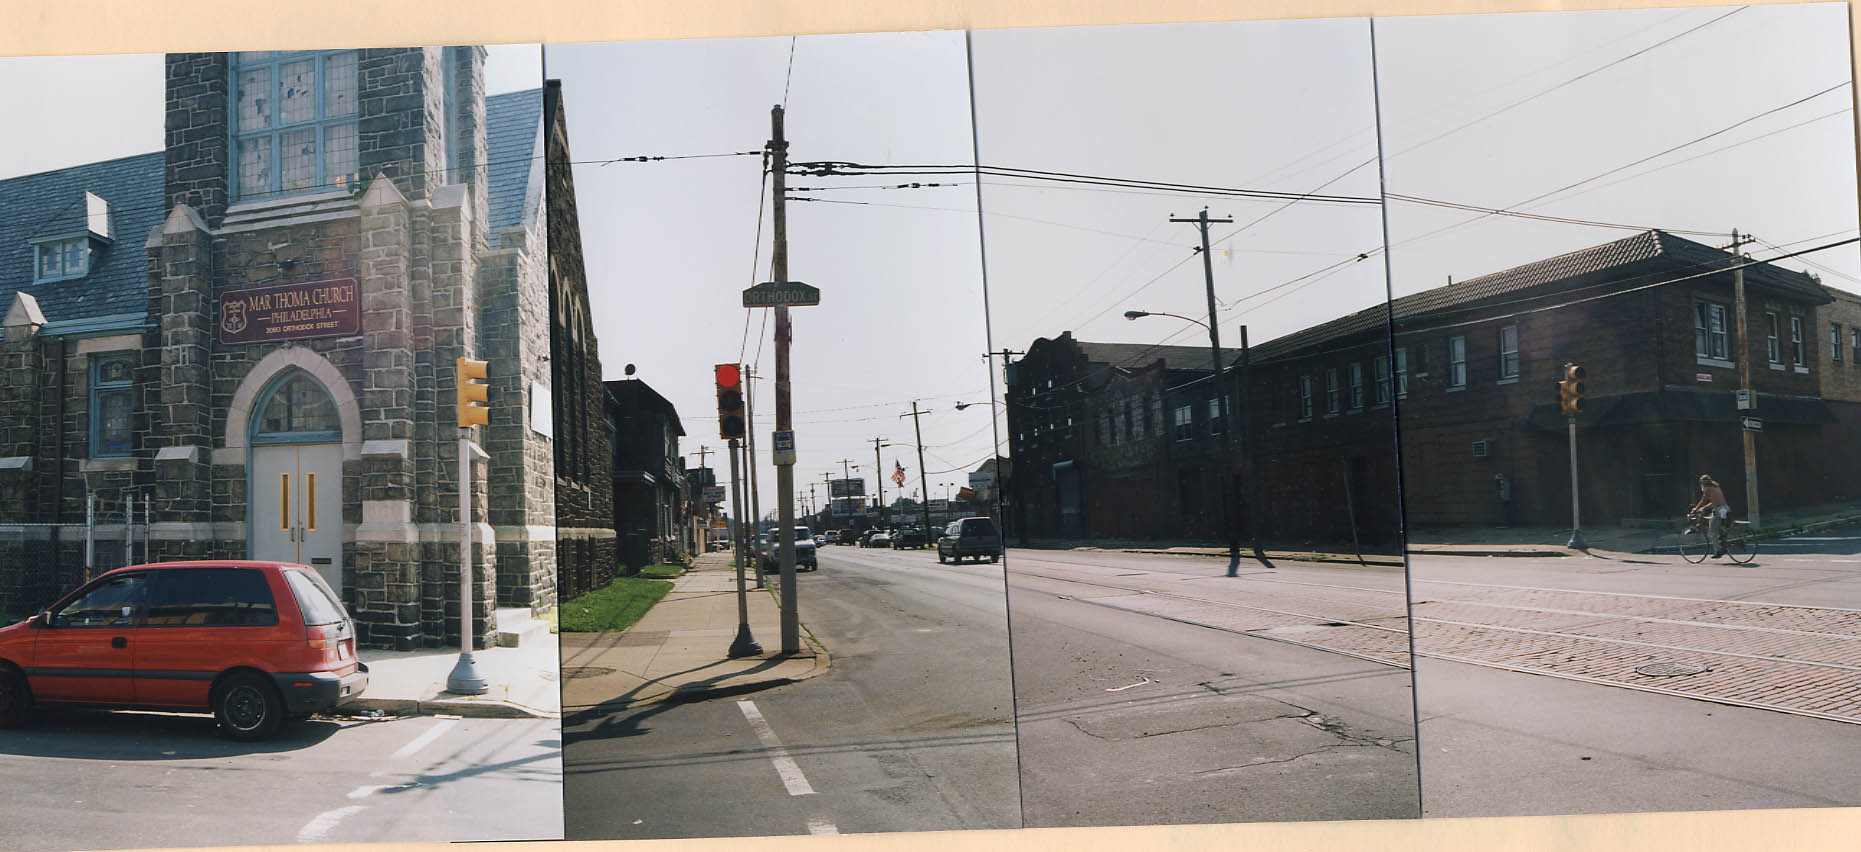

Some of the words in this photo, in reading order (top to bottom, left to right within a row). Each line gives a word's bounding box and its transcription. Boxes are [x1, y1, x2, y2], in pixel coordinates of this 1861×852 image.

[249, 294, 272, 311] MAR
[275, 290, 310, 309] THOMA
[313, 286, 353, 304] CHURCH
[744, 290, 806, 303] ORTHODOX
[271, 309, 332, 323] PHILADELPHIA
[283, 324, 314, 332] ORTHODOX
[316, 321, 339, 329] STREET
